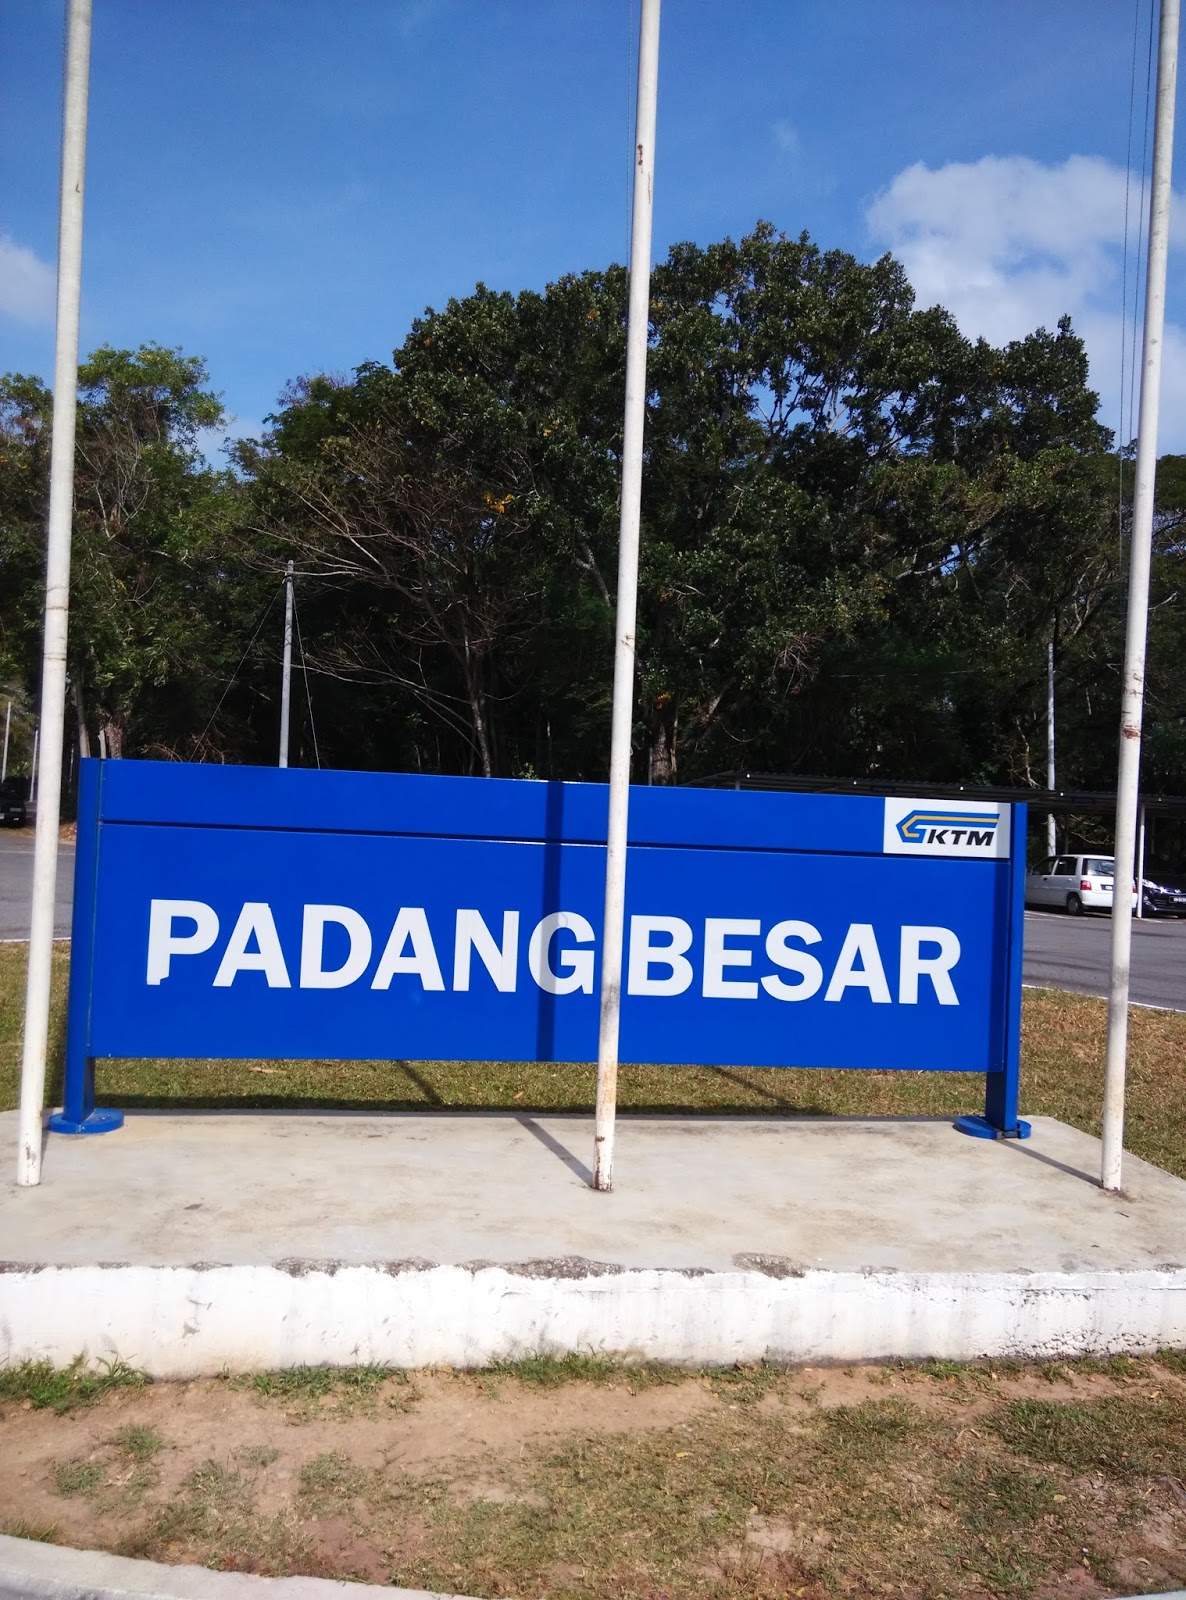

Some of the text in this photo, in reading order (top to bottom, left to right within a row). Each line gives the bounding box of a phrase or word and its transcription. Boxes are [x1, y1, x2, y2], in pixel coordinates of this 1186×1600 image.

[927, 828, 995, 846] KTM
[146, 899, 961, 1006] PADANG BESAR
